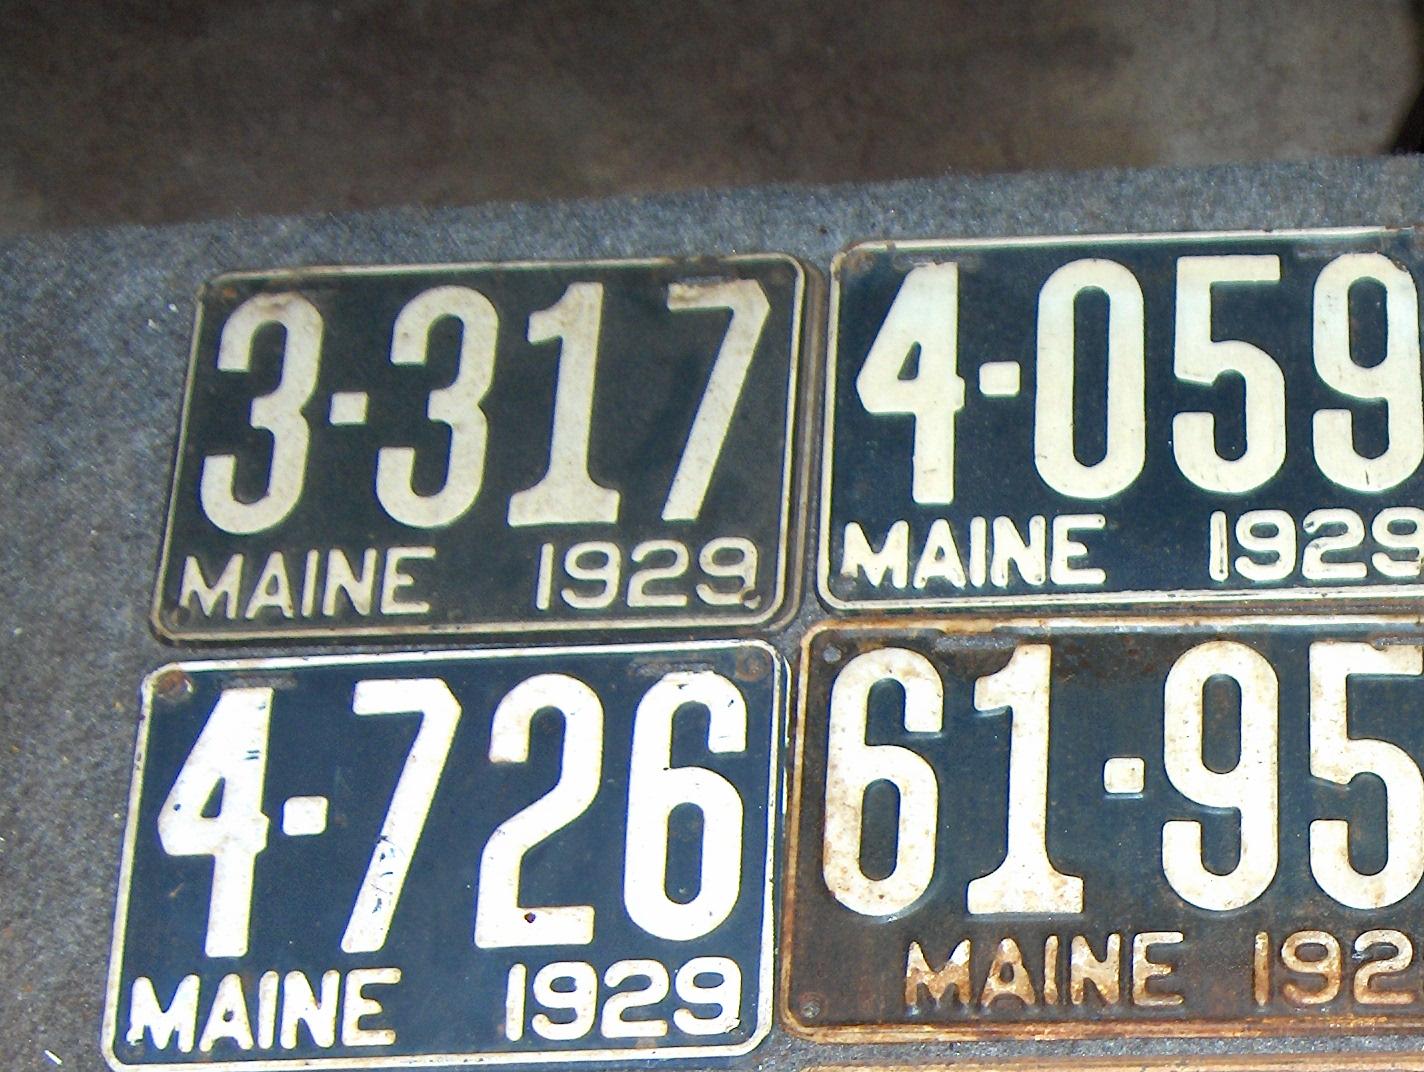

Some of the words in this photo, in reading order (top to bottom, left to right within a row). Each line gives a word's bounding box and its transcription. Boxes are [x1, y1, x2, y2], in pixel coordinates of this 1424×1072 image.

[200, 279, 771, 534] 3-317
[178, 545, 437, 621] MAINE
[535, 536, 761, 611] 1929
[841, 512, 1107, 590] MAINE
[156, 671, 748, 959] 4-726
[127, 967, 402, 1054] MAINE
[505, 956, 743, 1042] 1929
[903, 929, 1186, 1010] MAINE
